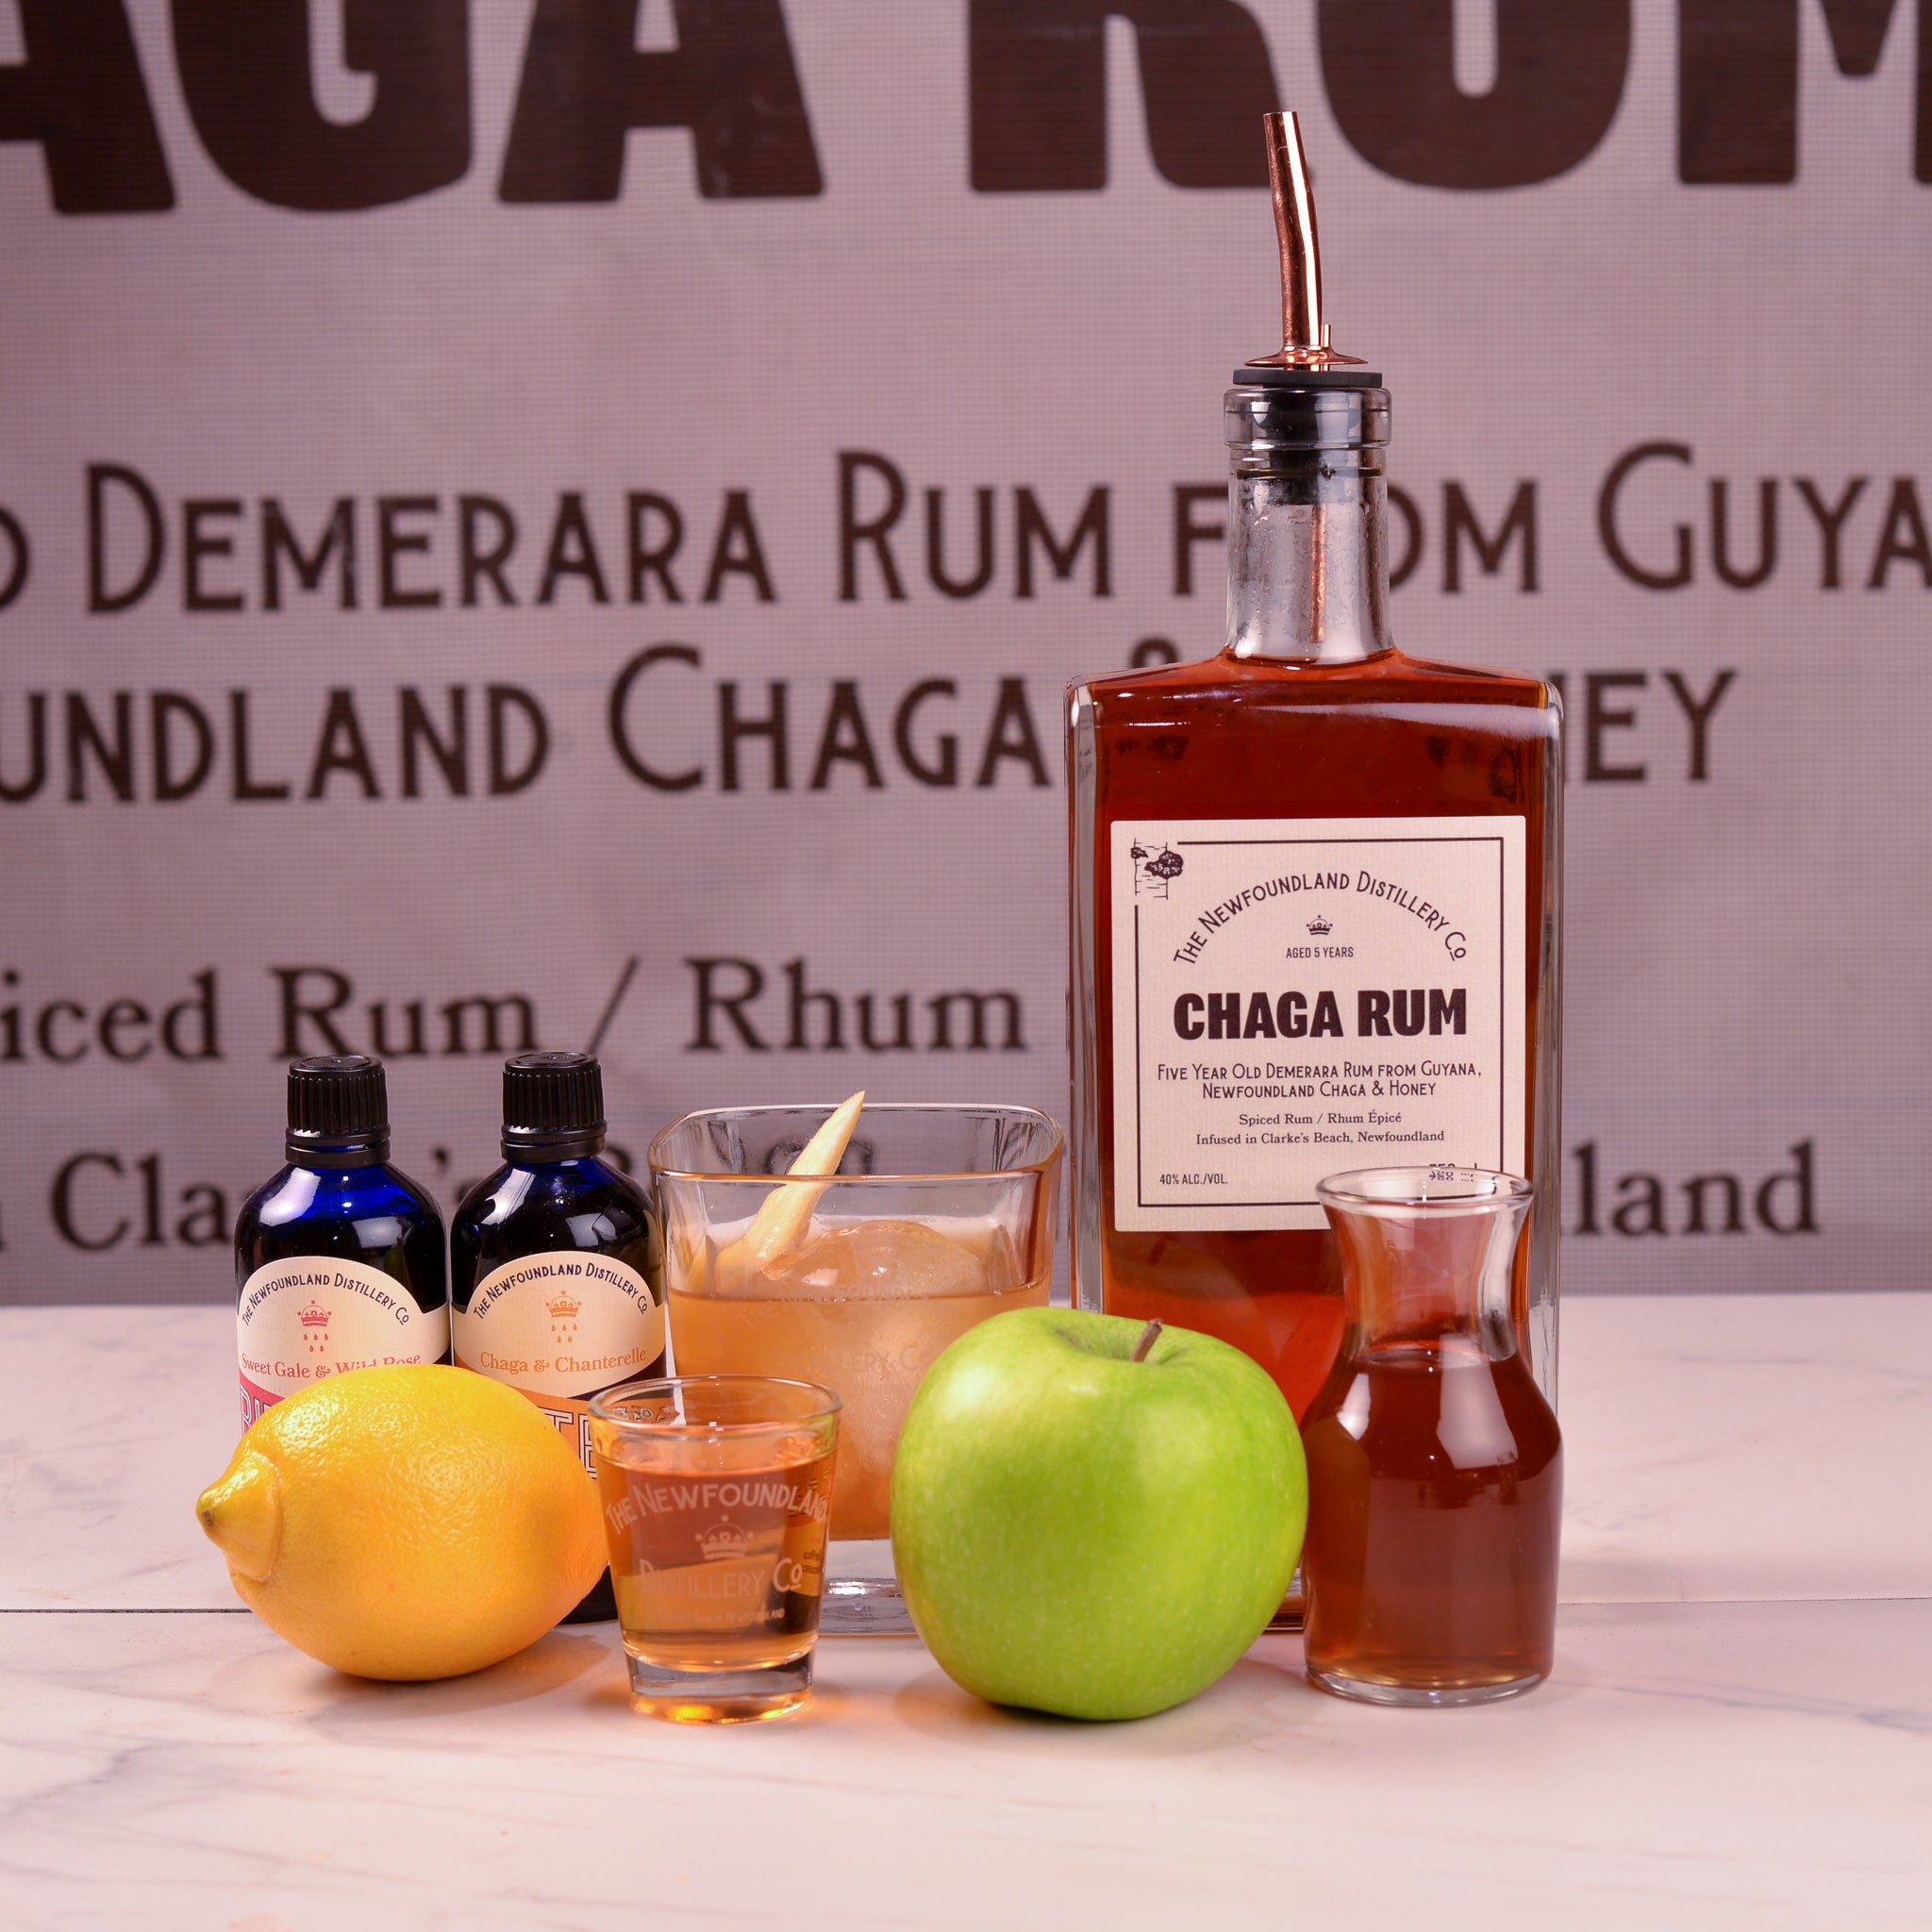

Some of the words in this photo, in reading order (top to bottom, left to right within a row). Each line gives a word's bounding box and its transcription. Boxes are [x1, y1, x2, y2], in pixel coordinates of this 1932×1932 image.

[87, 460, 777, 615] DEMERARA
[836, 448, 1113, 606] RUM
[608, 641, 1052, 794] CHAGA
[1174, 931, 1208, 964] THE
[1198, 873, 1349, 934] NEWFOUNDLAND
[1357, 870, 1450, 932] DISTILLERY
[1286, 947, 1310, 958] AGED
[1313, 946, 1320, 958] 5
[1323, 946, 1354, 958] YEARS
[271, 964, 544, 1058] Rum
[684, 953, 1030, 1054] Rhum
[1174, 991, 1344, 1040] CHAGA
[1357, 989, 1467, 1037] RUM
[1158, 1064, 1188, 1080] FIVE
[1191, 1064, 1227, 1079] YEAR
[1232, 1063, 1261, 1079] OLD
[1266, 1062, 1339, 1079] DEMERARA
[1343, 1061, 1373, 1077] RUM
[1378, 1063, 1416, 1077] FROM
[1203, 1082, 1315, 1099] NEWFOUNDLAND
[1320, 1081, 1367, 1097] CHAGA
[1372, 1080, 1385, 1096] &
[1390, 1080, 1437, 1096] HONEY
[1196, 1134, 1242, 1145] Infused
[1245, 1133, 1257, 1144] in
[1261, 1132, 1310, 1144] Clarke's
[1314, 1132, 1354, 1144] Beach,
[1357, 1130, 1445, 1143] Newfoundland
[1239, 1113, 1280, 1126] Spiced
[1285, 1113, 1313, 1124] Rum
[1317, 1112, 1324, 1125] /
[1327, 1111, 1364, 1124] Rhum
[1368, 1108, 1402, 1126] Épicé
[1159, 1174, 1180, 1185] 40%
[1182, 1174, 1228, 1186] ALC./VOL.
[242, 1306, 254, 1326] THE
[250, 1274, 330, 1311] NEWFOUNDLAND
[334, 1273, 397, 1310] DISTILLERY
[474, 1298, 491, 1319] THE
[486, 1263, 582, 1302] NEWFOUNDLAND
[586, 1262, 640, 1300] DISTILLERY
[242, 1353, 271, 1375] Sweet
[275, 1361, 310, 1378] Gale
[315, 1365, 331, 1378] &
[480, 1351, 529, 1375] Chaga
[534, 1359, 550, 1373] &
[555, 1347, 646, 1374] Chanterelle
[606, 1496, 639, 1535] THE
[633, 1483, 828, 1524] NEWFOUNDLAND
[640, 1557, 765, 1599] DISTILLERY
